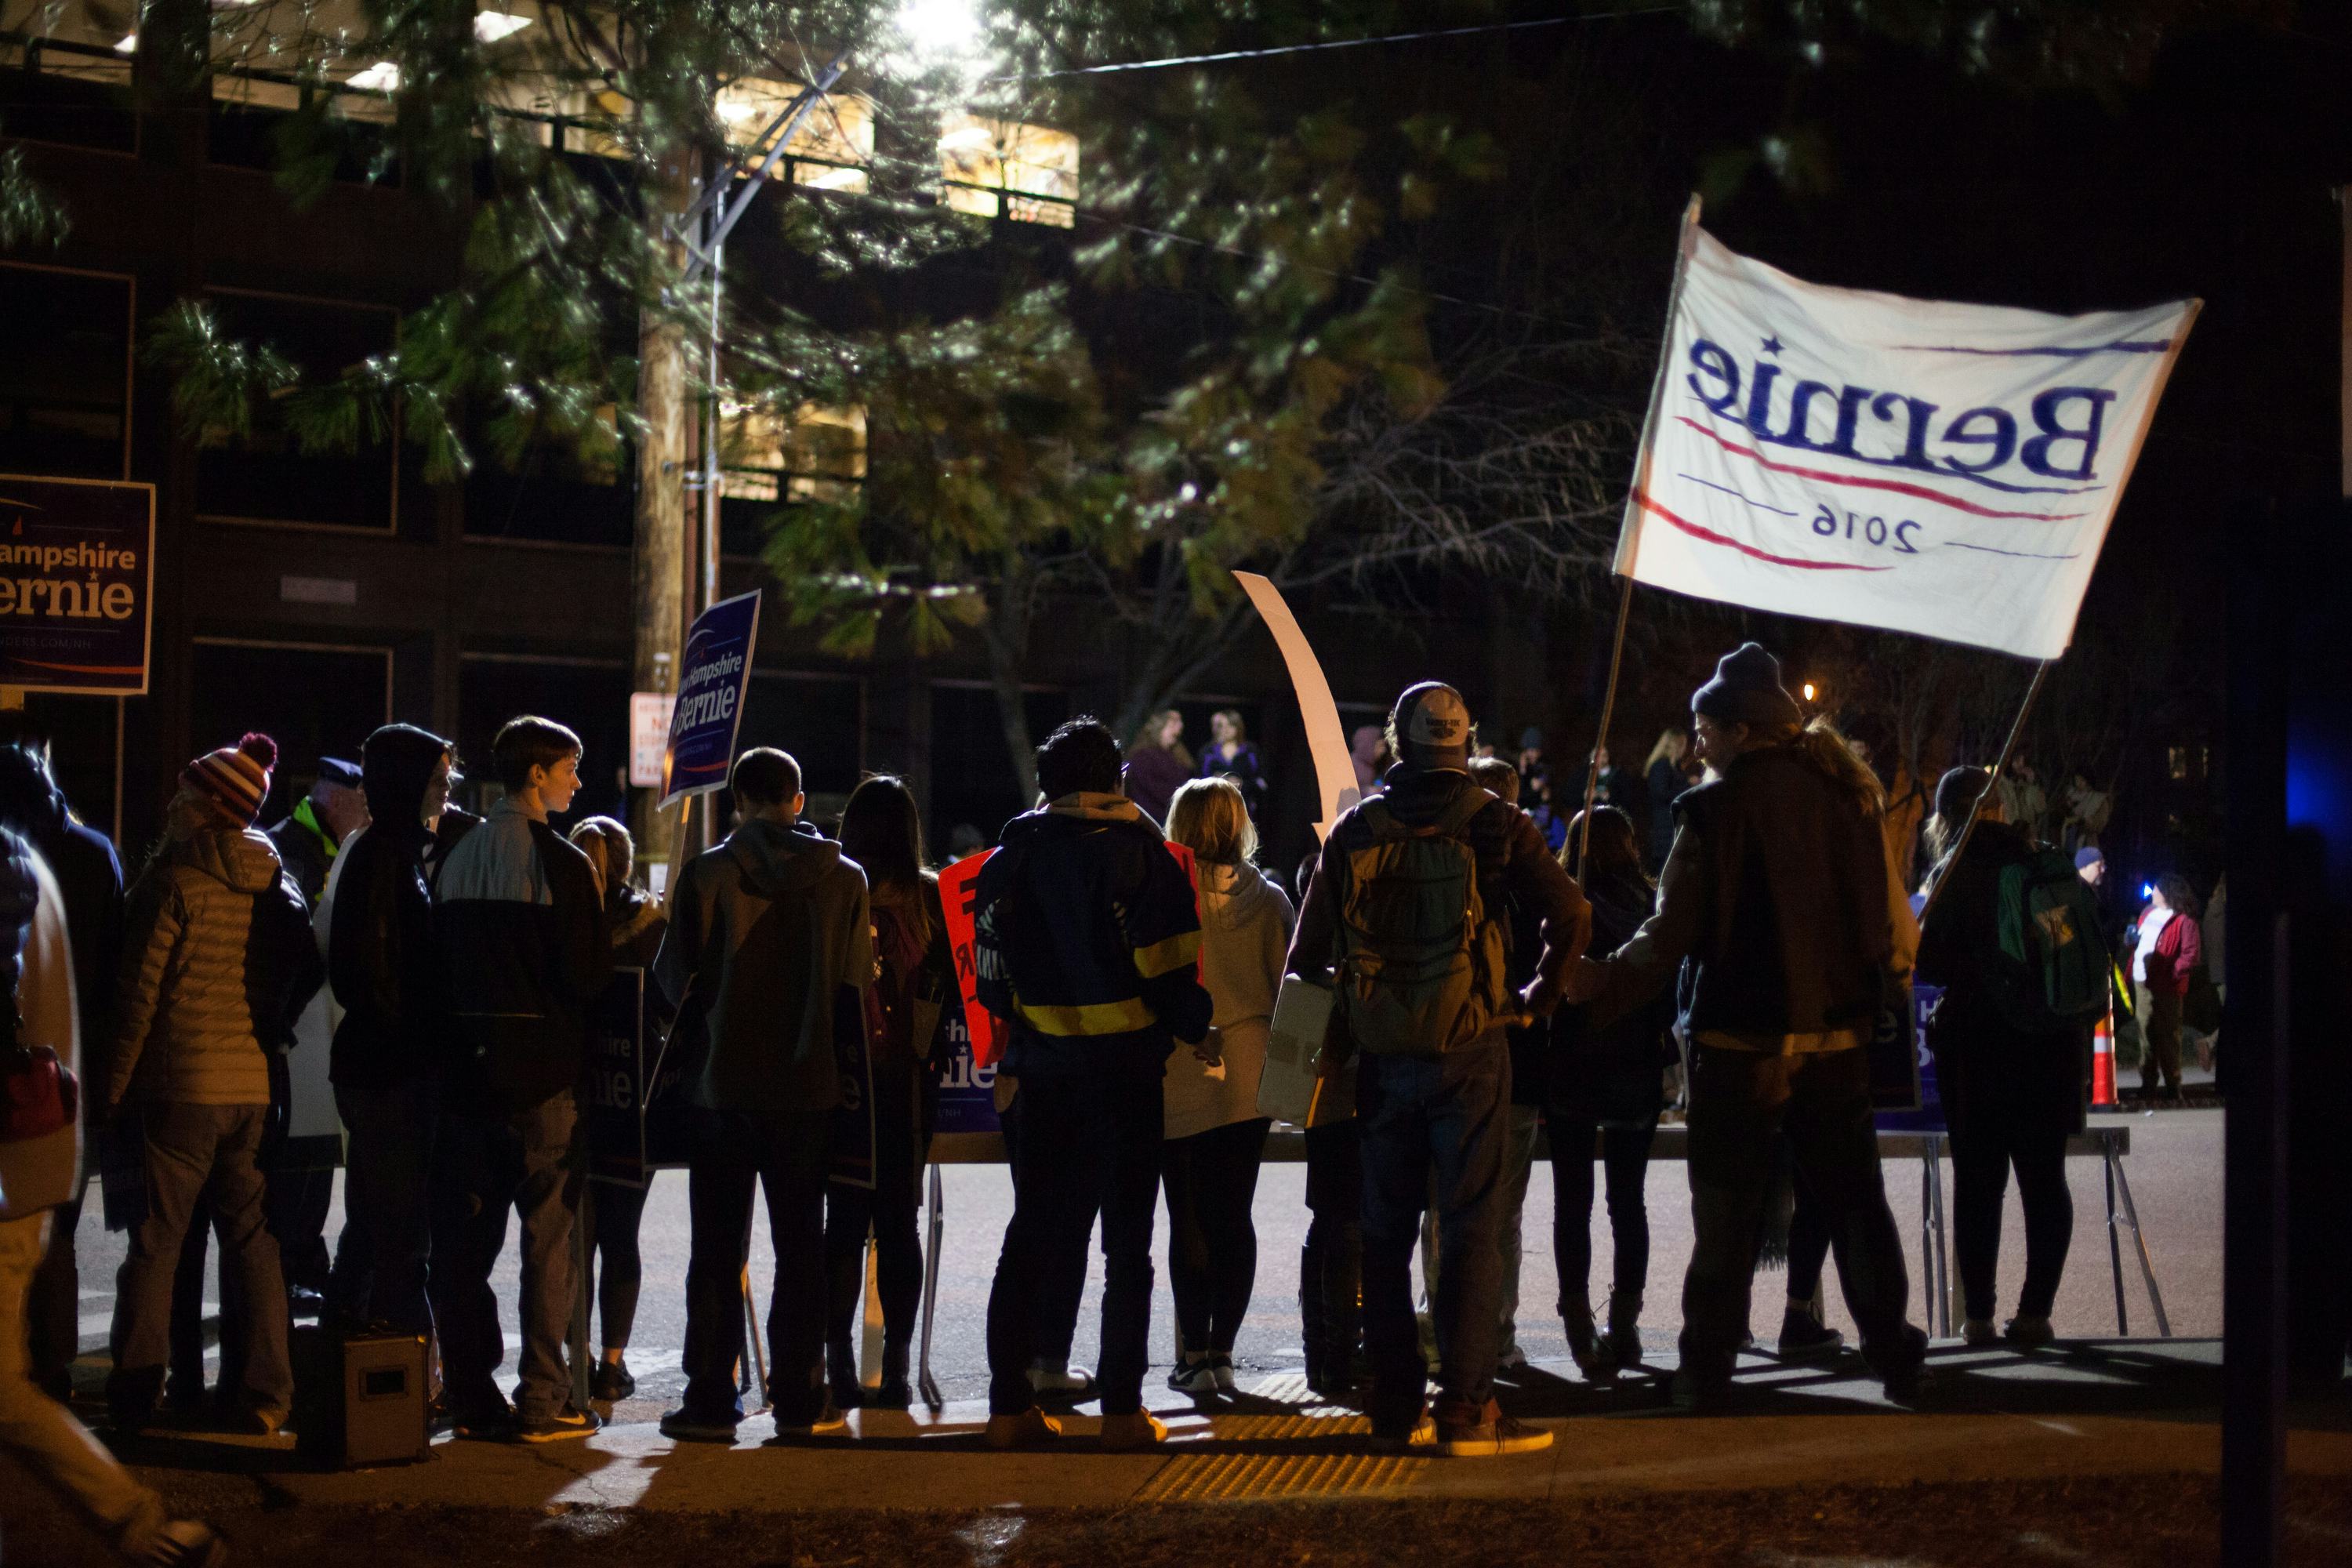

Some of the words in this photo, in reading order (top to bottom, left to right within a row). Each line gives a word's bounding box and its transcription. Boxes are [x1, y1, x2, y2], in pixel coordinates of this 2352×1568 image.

[0, 541, 136, 573] ampshire
[690, 652, 742, 687] Hampshire
[676, 680, 736, 736] Bernie
